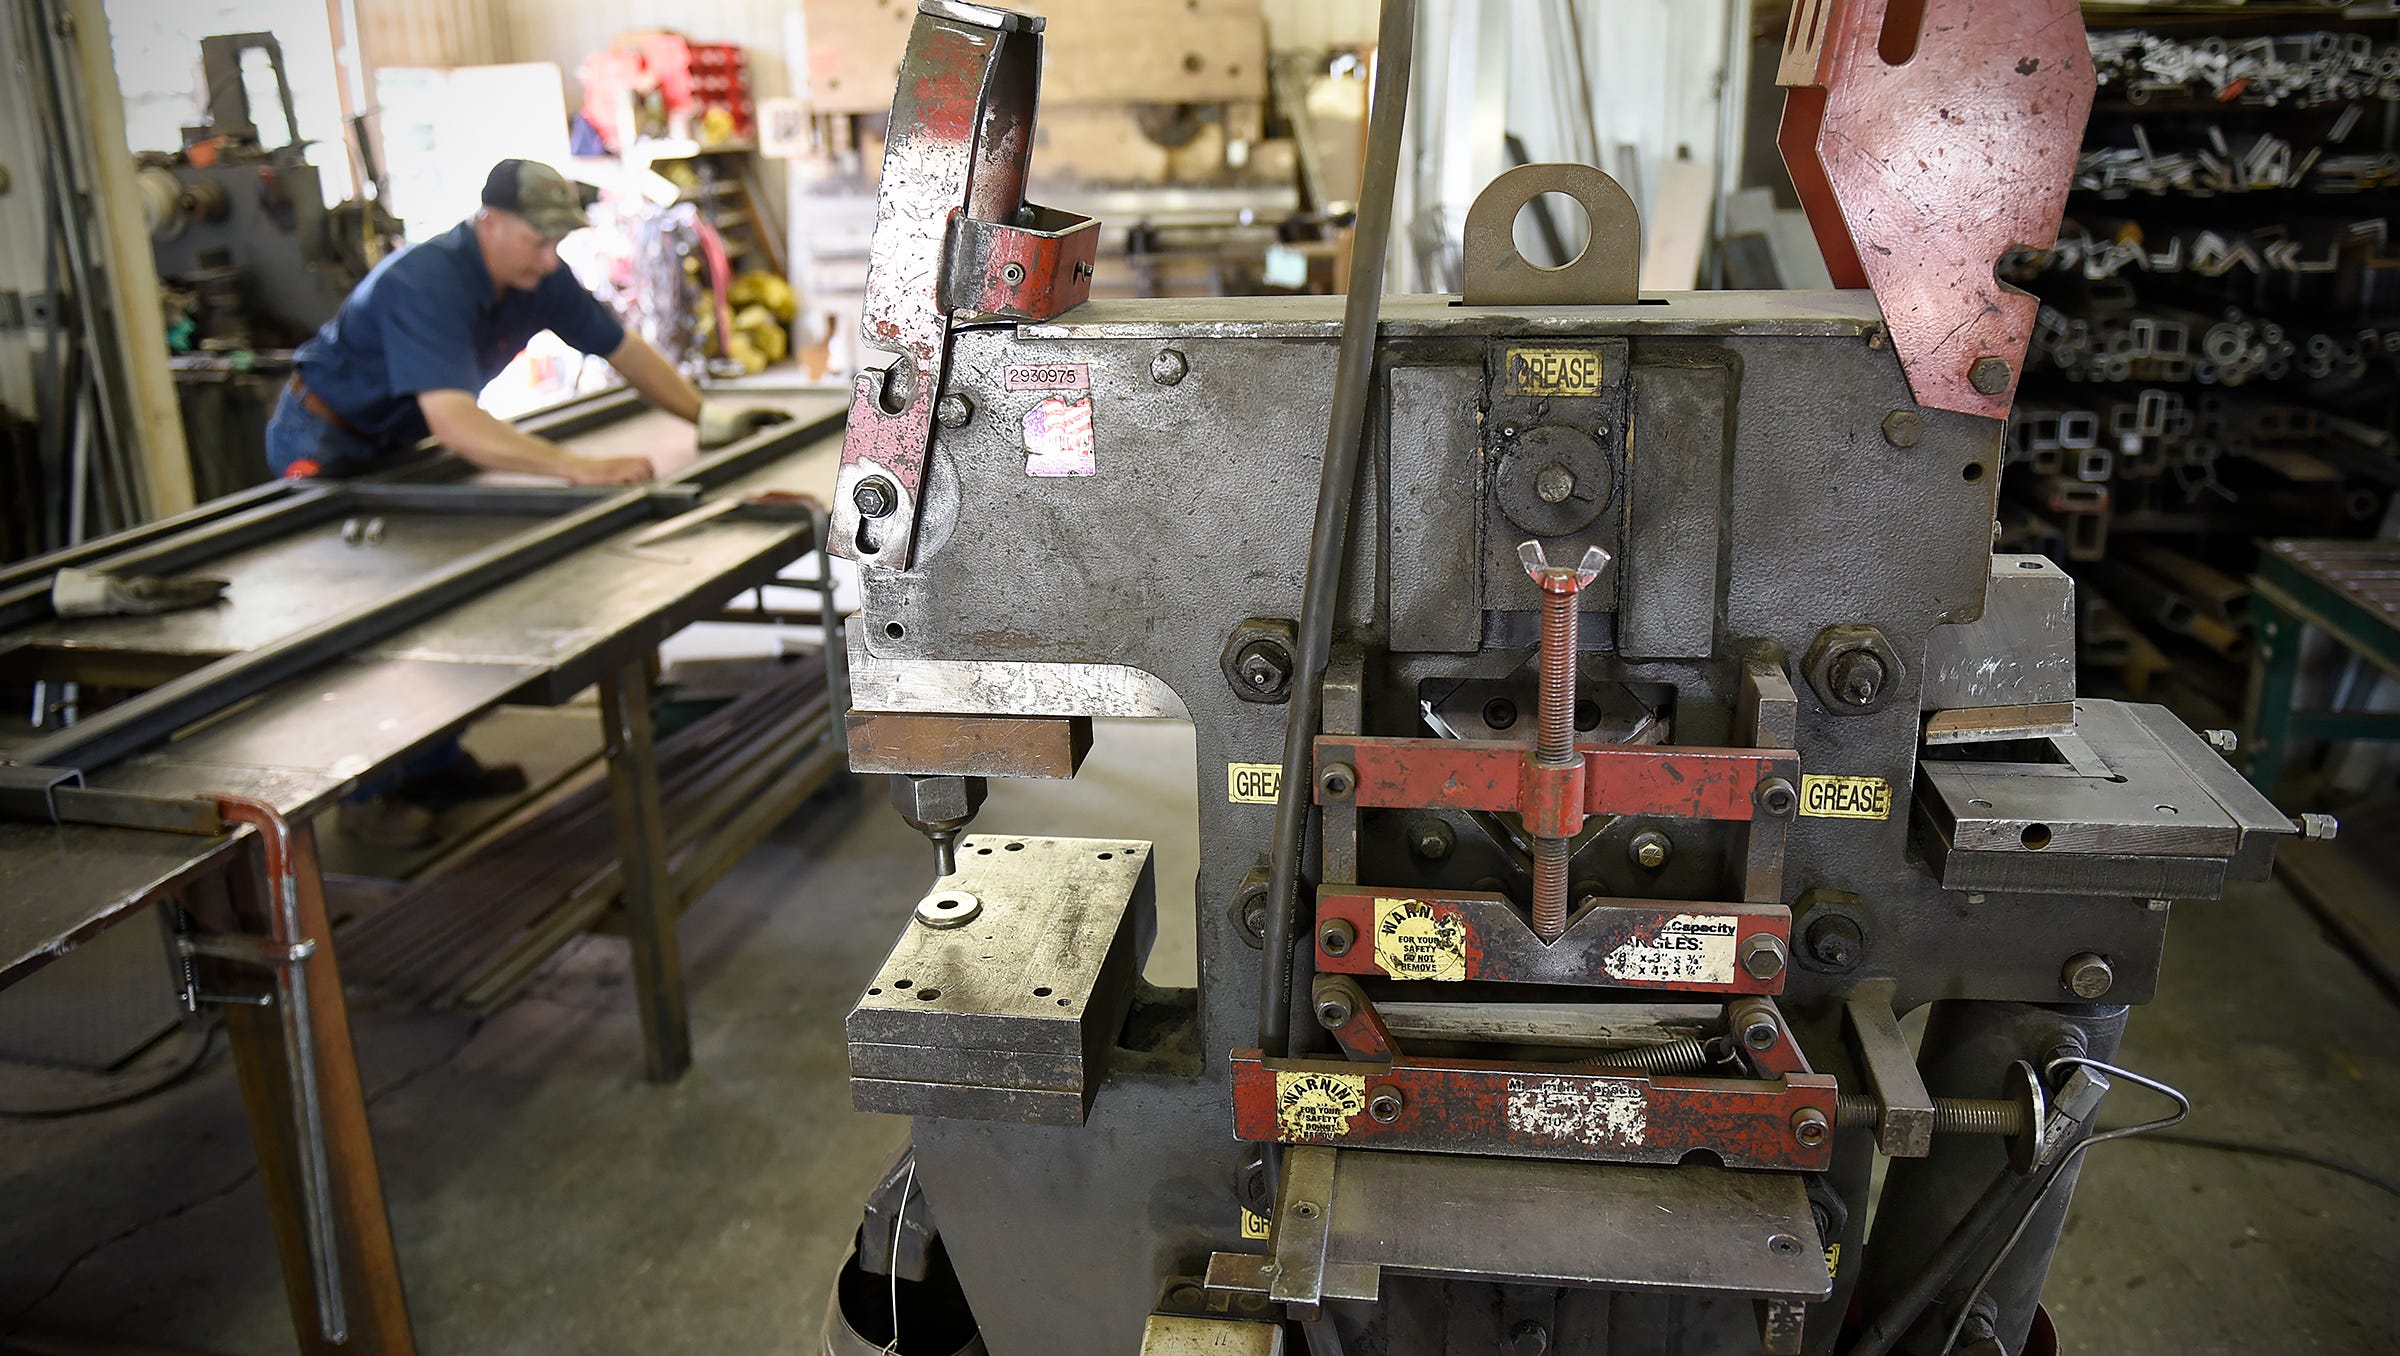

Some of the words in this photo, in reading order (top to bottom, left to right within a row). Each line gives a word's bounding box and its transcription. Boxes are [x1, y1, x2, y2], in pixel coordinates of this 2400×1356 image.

[1010, 369, 1076, 383] 2930975
[1237, 771, 1281, 797] GREA
[1810, 783, 1886, 812] GREASE
[1671, 921, 1736, 936] Capacity
[1398, 936, 1414, 944] FOR
[1404, 945, 1437, 953] SAFETY
[1418, 954, 1435, 963] NOT
[1401, 963, 1437, 972] REMOVE
[1284, 1078, 1356, 1109] WARNING
[1301, 1106, 1316, 1114] FOR
[1319, 1107, 1341, 1115] YOUR
